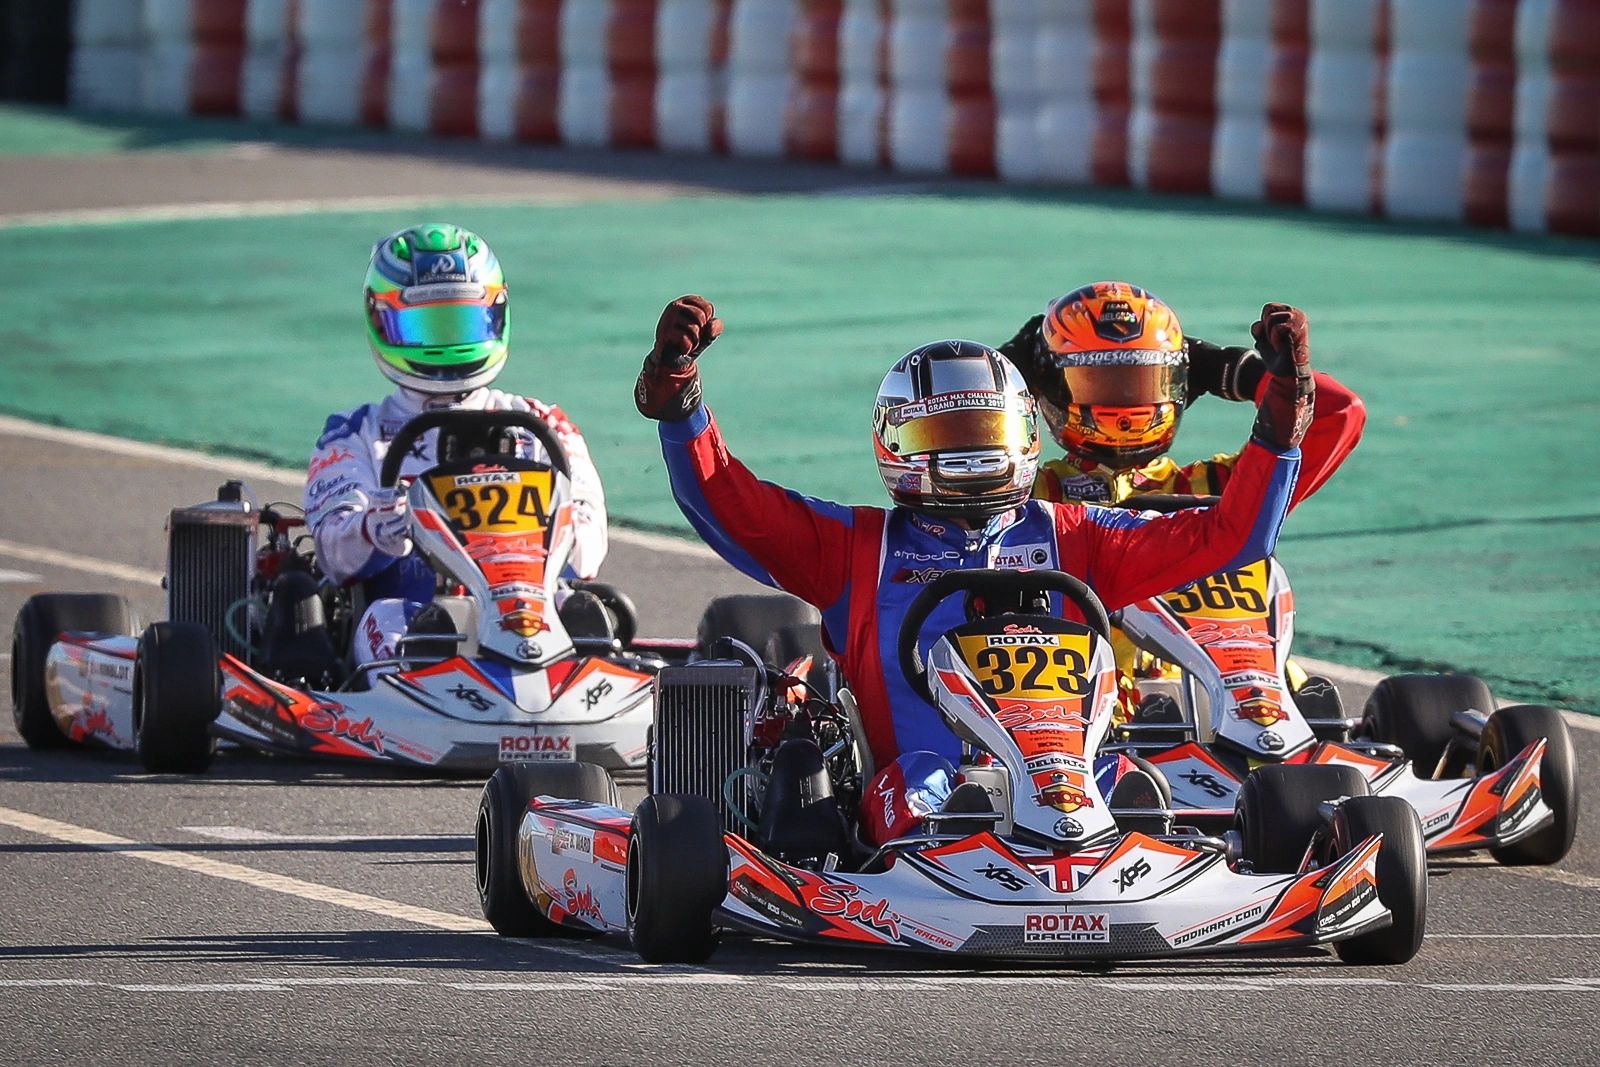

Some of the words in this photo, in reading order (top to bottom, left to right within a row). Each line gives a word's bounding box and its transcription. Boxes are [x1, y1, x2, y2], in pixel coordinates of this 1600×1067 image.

[927, 396, 947, 405] ROTAX
[967, 391, 1004, 400] CHALLENG
[928, 401, 955, 412] GRAND
[957, 398, 986, 407] FINALS
[902, 405, 924, 415] ROTAX
[456, 473, 518, 486] ROTAX
[445, 484, 550, 532] 324
[1168, 568, 1269, 614] 365
[989, 635, 1057, 647] ROTAX
[976, 646, 1092, 696] 323
[500, 735, 572, 751] ROTAX
[1177, 768, 1234, 799] XPS
[973, 862, 1035, 892] XPS
[1112, 856, 1152, 895] XPS
[809, 883, 901, 942] Sodi
[1026, 914, 1108, 932] ROTAX
[1173, 904, 1263, 947] SODIKART.COM
[914, 927, 955, 948] RACING
[1026, 932, 1104, 942] RACING
